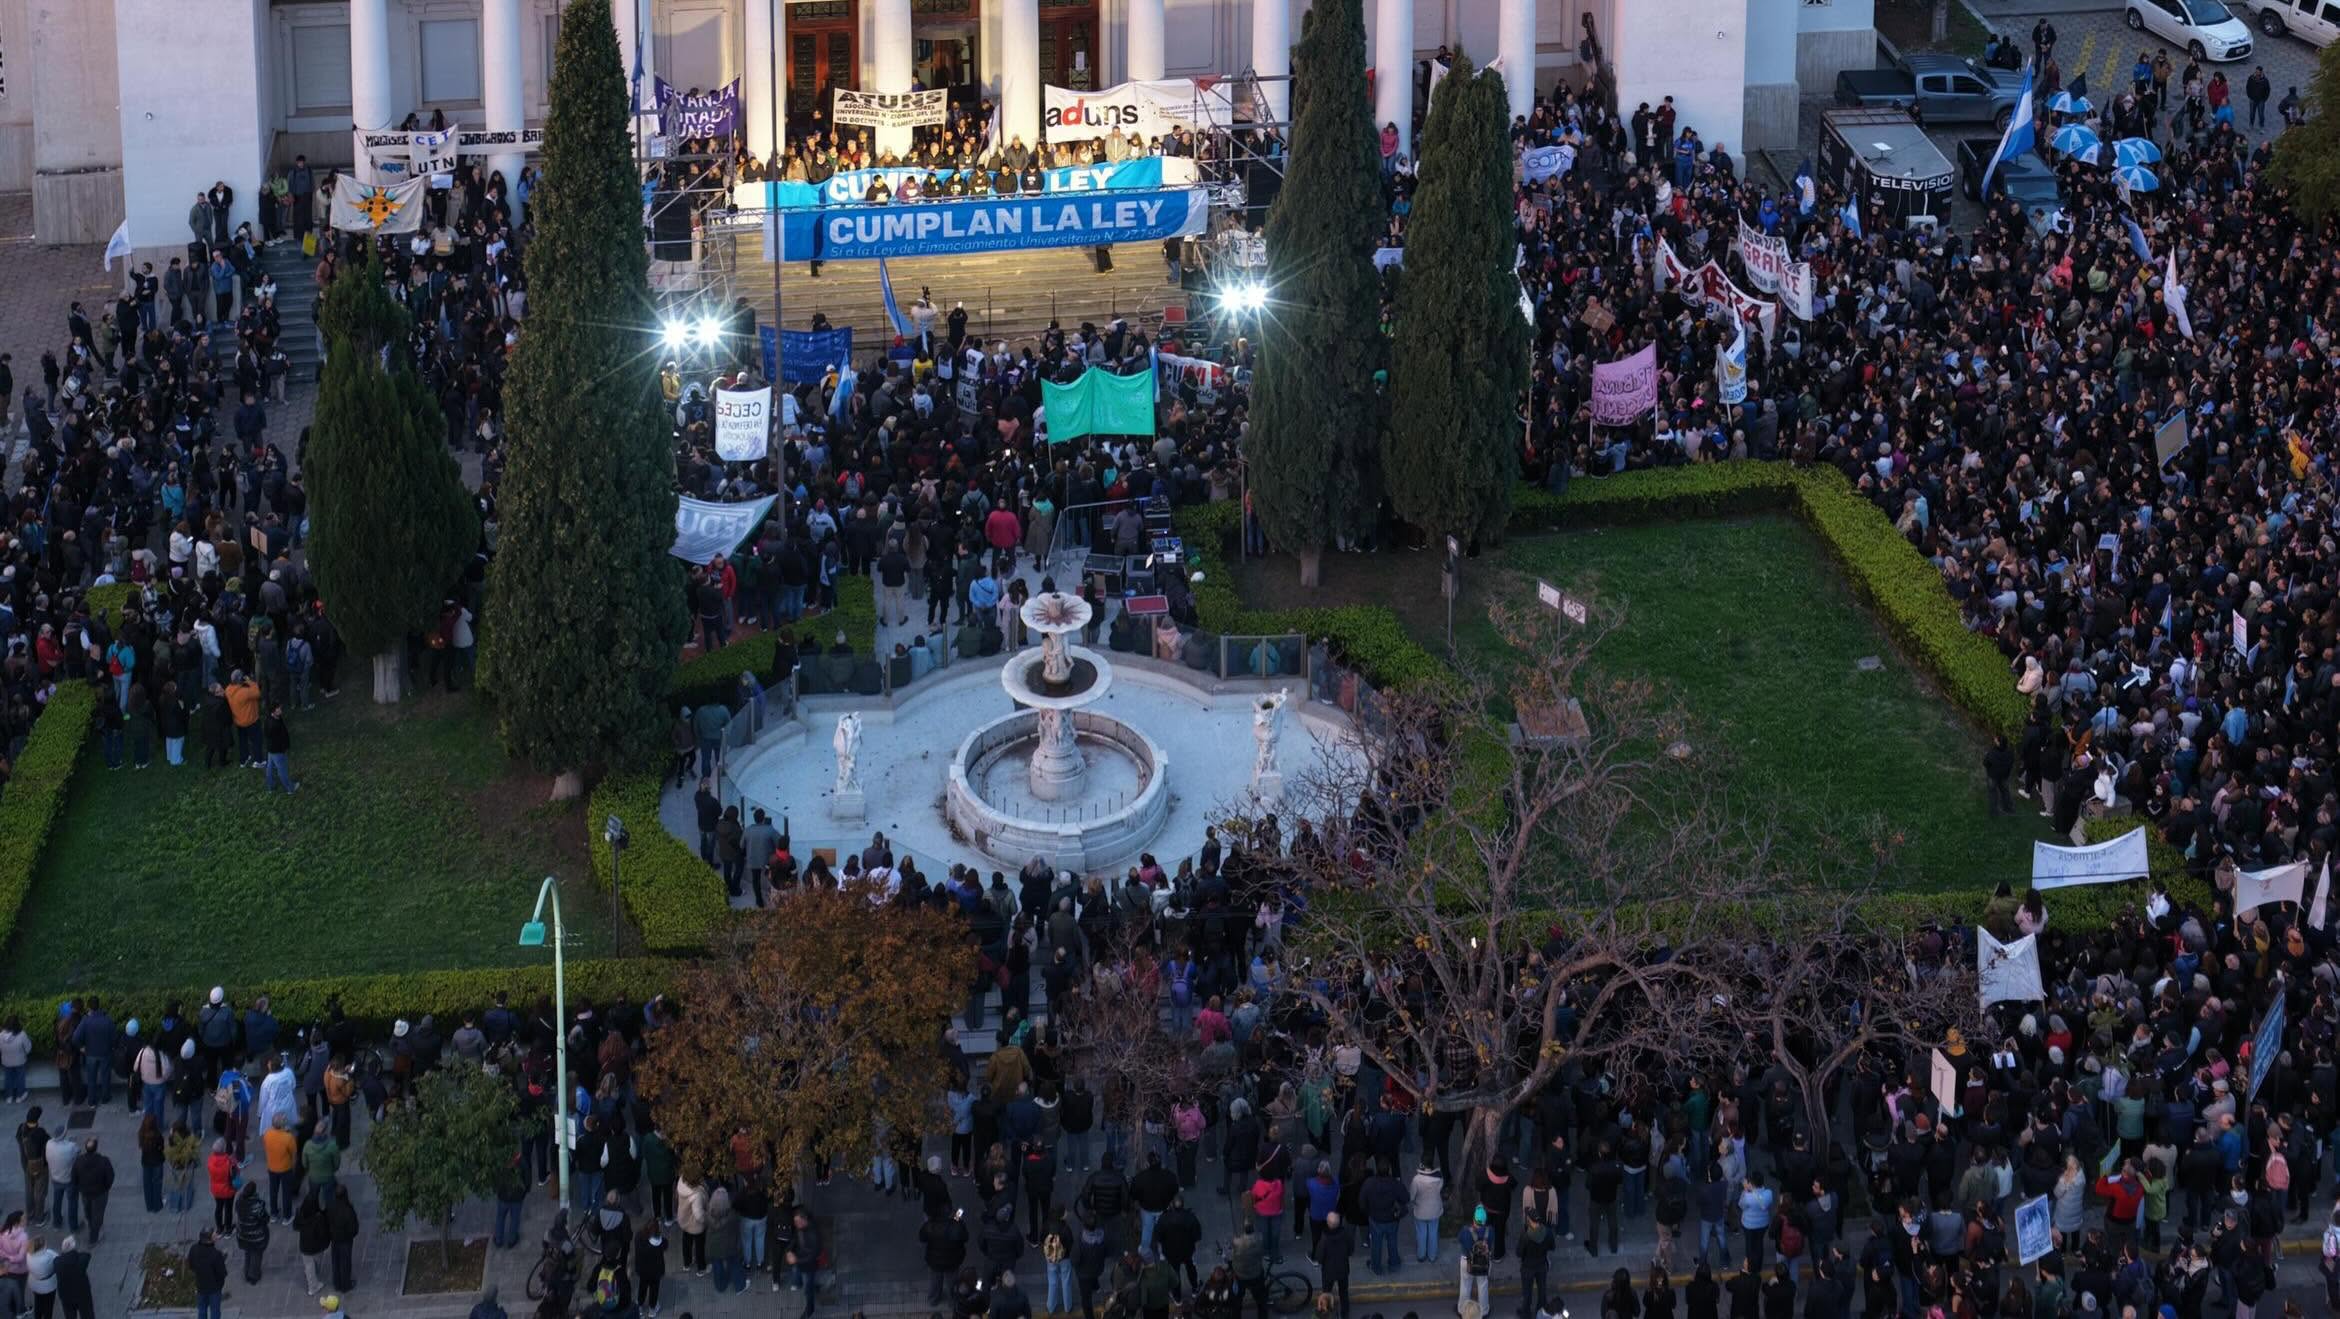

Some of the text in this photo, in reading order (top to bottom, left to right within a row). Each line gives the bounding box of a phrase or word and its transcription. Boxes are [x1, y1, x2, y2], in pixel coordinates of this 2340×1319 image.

[838, 91, 943, 109] ATUNS
[835, 109, 879, 117] UNIVERSIDAD
[881, 111, 914, 119] NCIONAL
[1046, 96, 1139, 127] aduns
[415, 131, 449, 146] CET
[418, 157, 454, 173] UTN
[1050, 166, 1113, 192] LEY
[829, 200, 1164, 245] CUMPLAN LA LEY
[857, 247, 869, 256] la
[873, 244, 896, 256] Ley
[899, 243, 914, 254] de
[918, 237, 1017, 252] Financiamiento
[1019, 233, 1100, 247] Universitario
